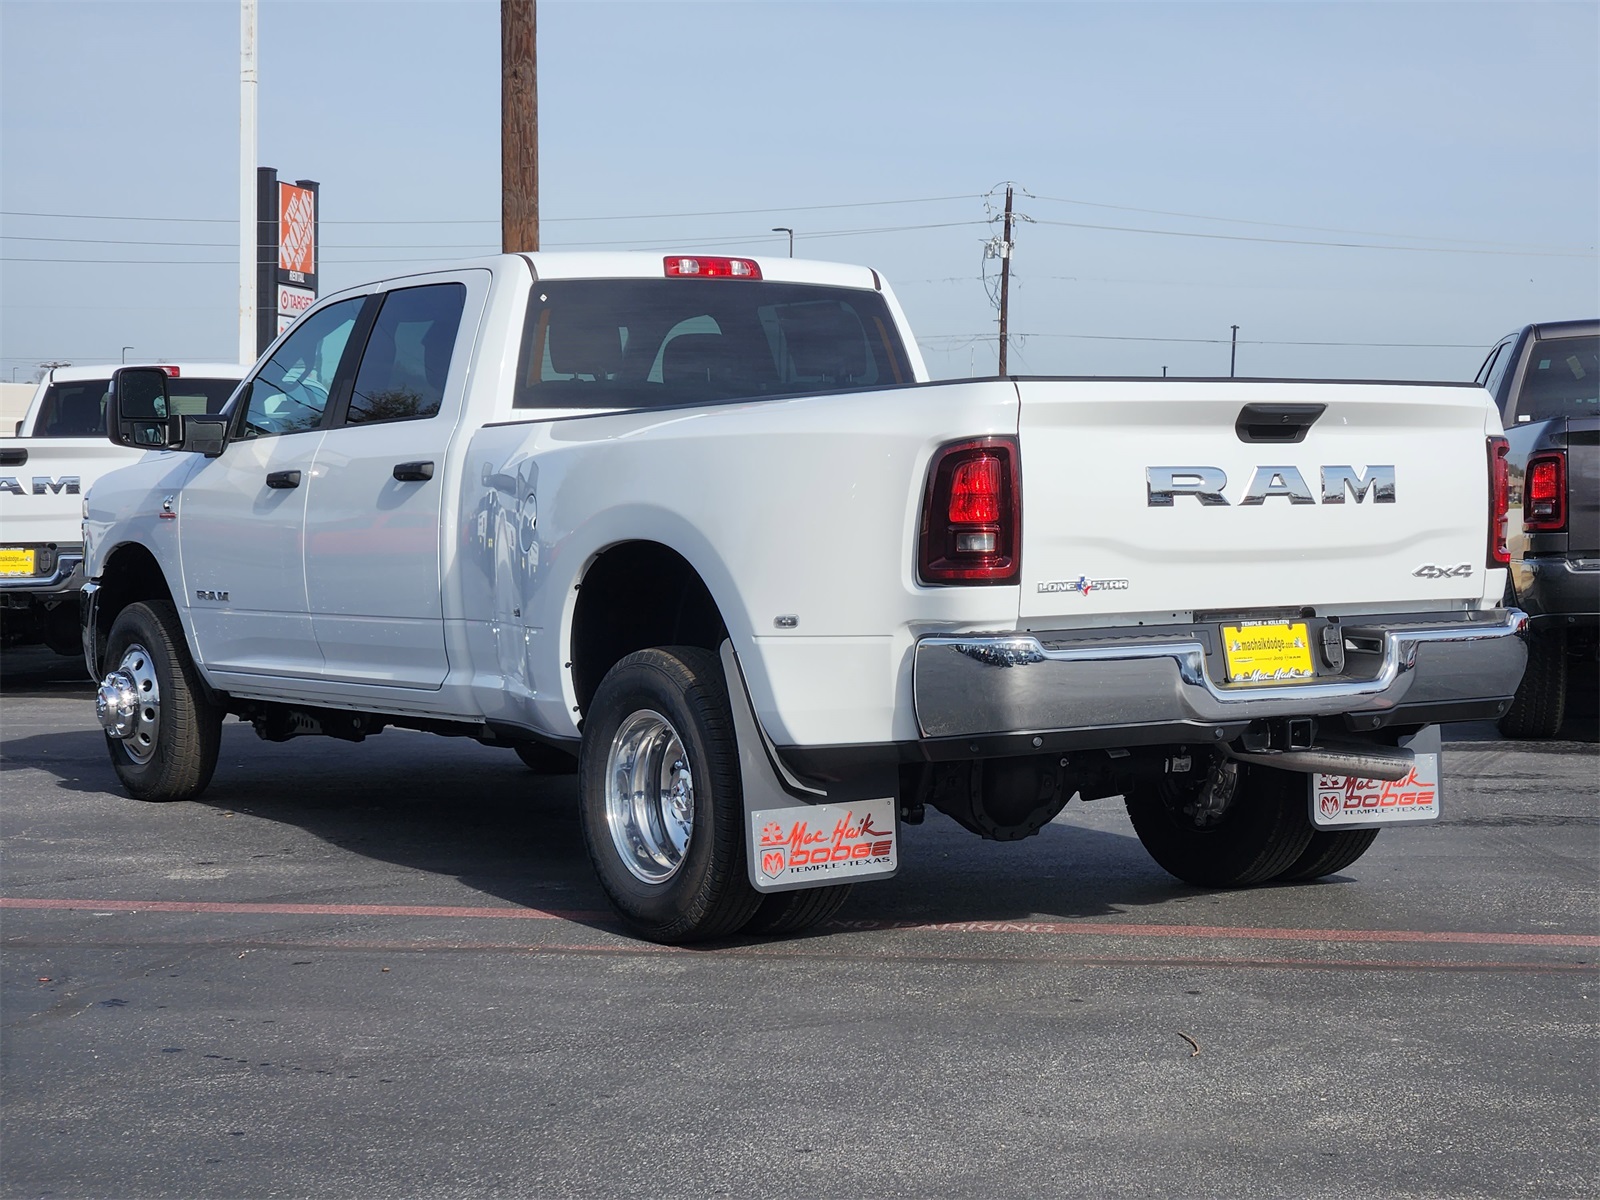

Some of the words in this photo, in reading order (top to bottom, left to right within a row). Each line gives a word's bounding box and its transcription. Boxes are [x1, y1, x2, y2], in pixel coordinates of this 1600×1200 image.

[281, 189, 312, 270] HOME
[294, 219, 313, 271] DEPOT
[289, 293, 313, 311] TARGET
[1145, 464, 1397, 507] RAM
[1037, 581, 1077, 593] LONE
[1090, 579, 1129, 591] STAR
[196, 590, 231, 603] RAM
[1251, 668, 1274, 682] Mac
[1341, 774, 1379, 799] Mac
[1343, 791, 1435, 809] DODGE
[1344, 807, 1389, 815] TEMPLE
[1393, 805, 1433, 813] TEXAS
[786, 821, 829, 853] Mac
[831, 810, 893, 850] Haik
[788, 839, 893, 867] DODGE
[789, 862, 840, 874] TEMPLE
[845, 856, 891, 867] TEXAS
